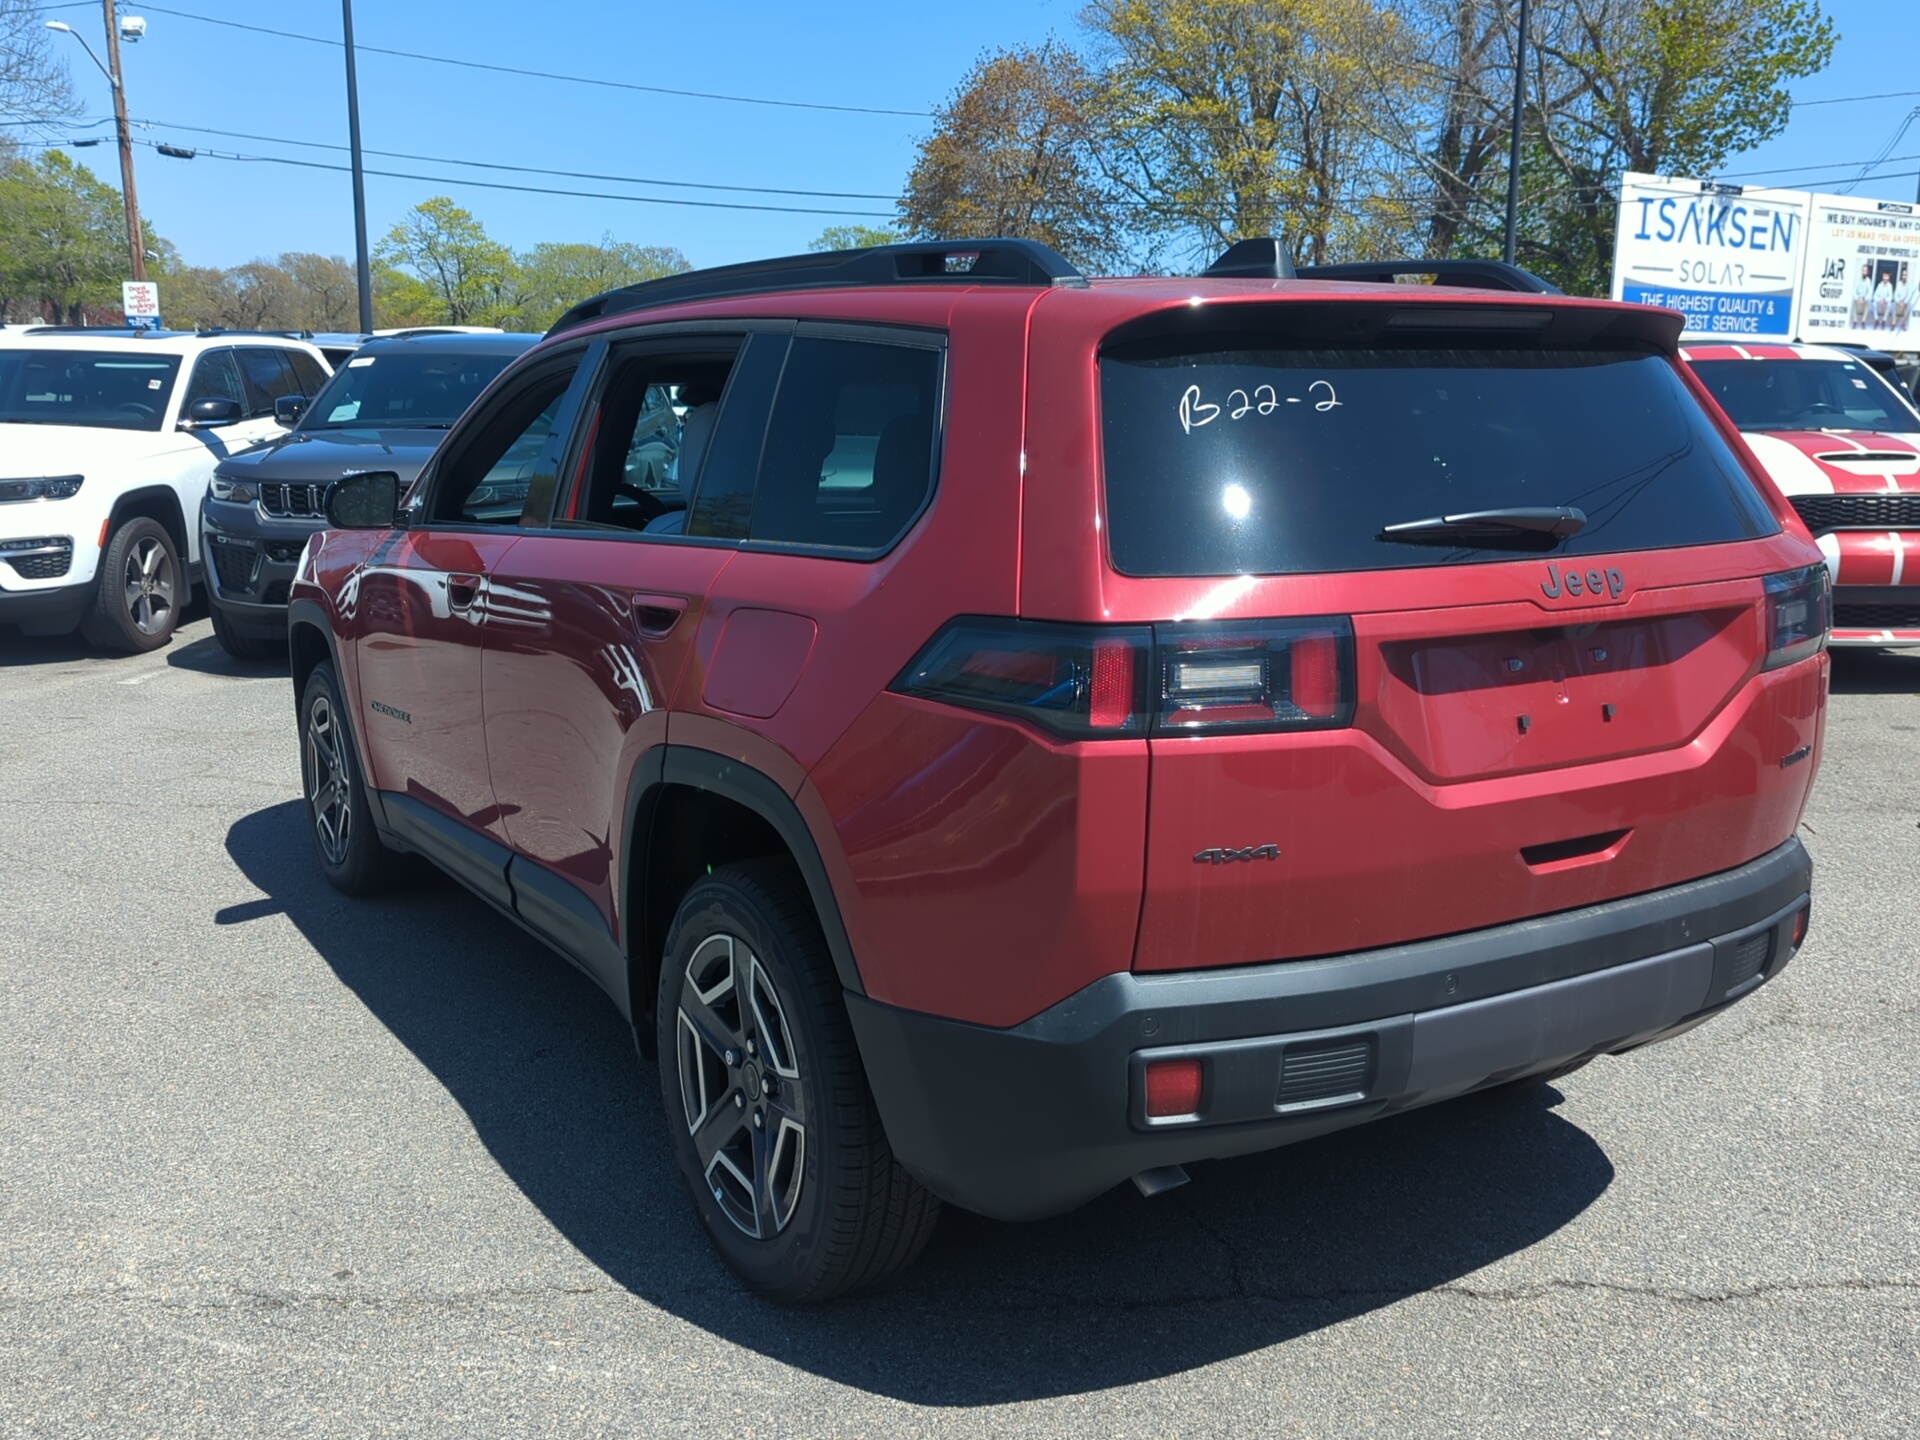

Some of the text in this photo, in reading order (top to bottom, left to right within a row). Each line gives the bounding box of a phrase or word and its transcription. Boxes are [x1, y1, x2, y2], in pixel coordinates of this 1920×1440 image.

[1634, 197, 1793, 253] ISAKSEN
[1827, 213, 1838, 223] WE
[1840, 214, 1855, 225] BUY
[1857, 216, 1887, 228] HOUSES
[1888, 218, 1896, 228] IN
[1898, 219, 1912, 230] ANY
[1831, 228, 1844, 237] LET
[1846, 230, 1855, 238] US
[1857, 231, 1875, 240] MAKE
[1878, 232, 1890, 242] YOU
[1679, 259, 1745, 286] SOLAR
[1821, 257, 1845, 280] JAR
[1819, 281, 1843, 299] GROUP
[1640, 292, 1775, 316] THE HIGHEST QUALITY &
[1712, 315, 1759, 333] SERVICE
[1541, 565, 1625, 599] Jeep
